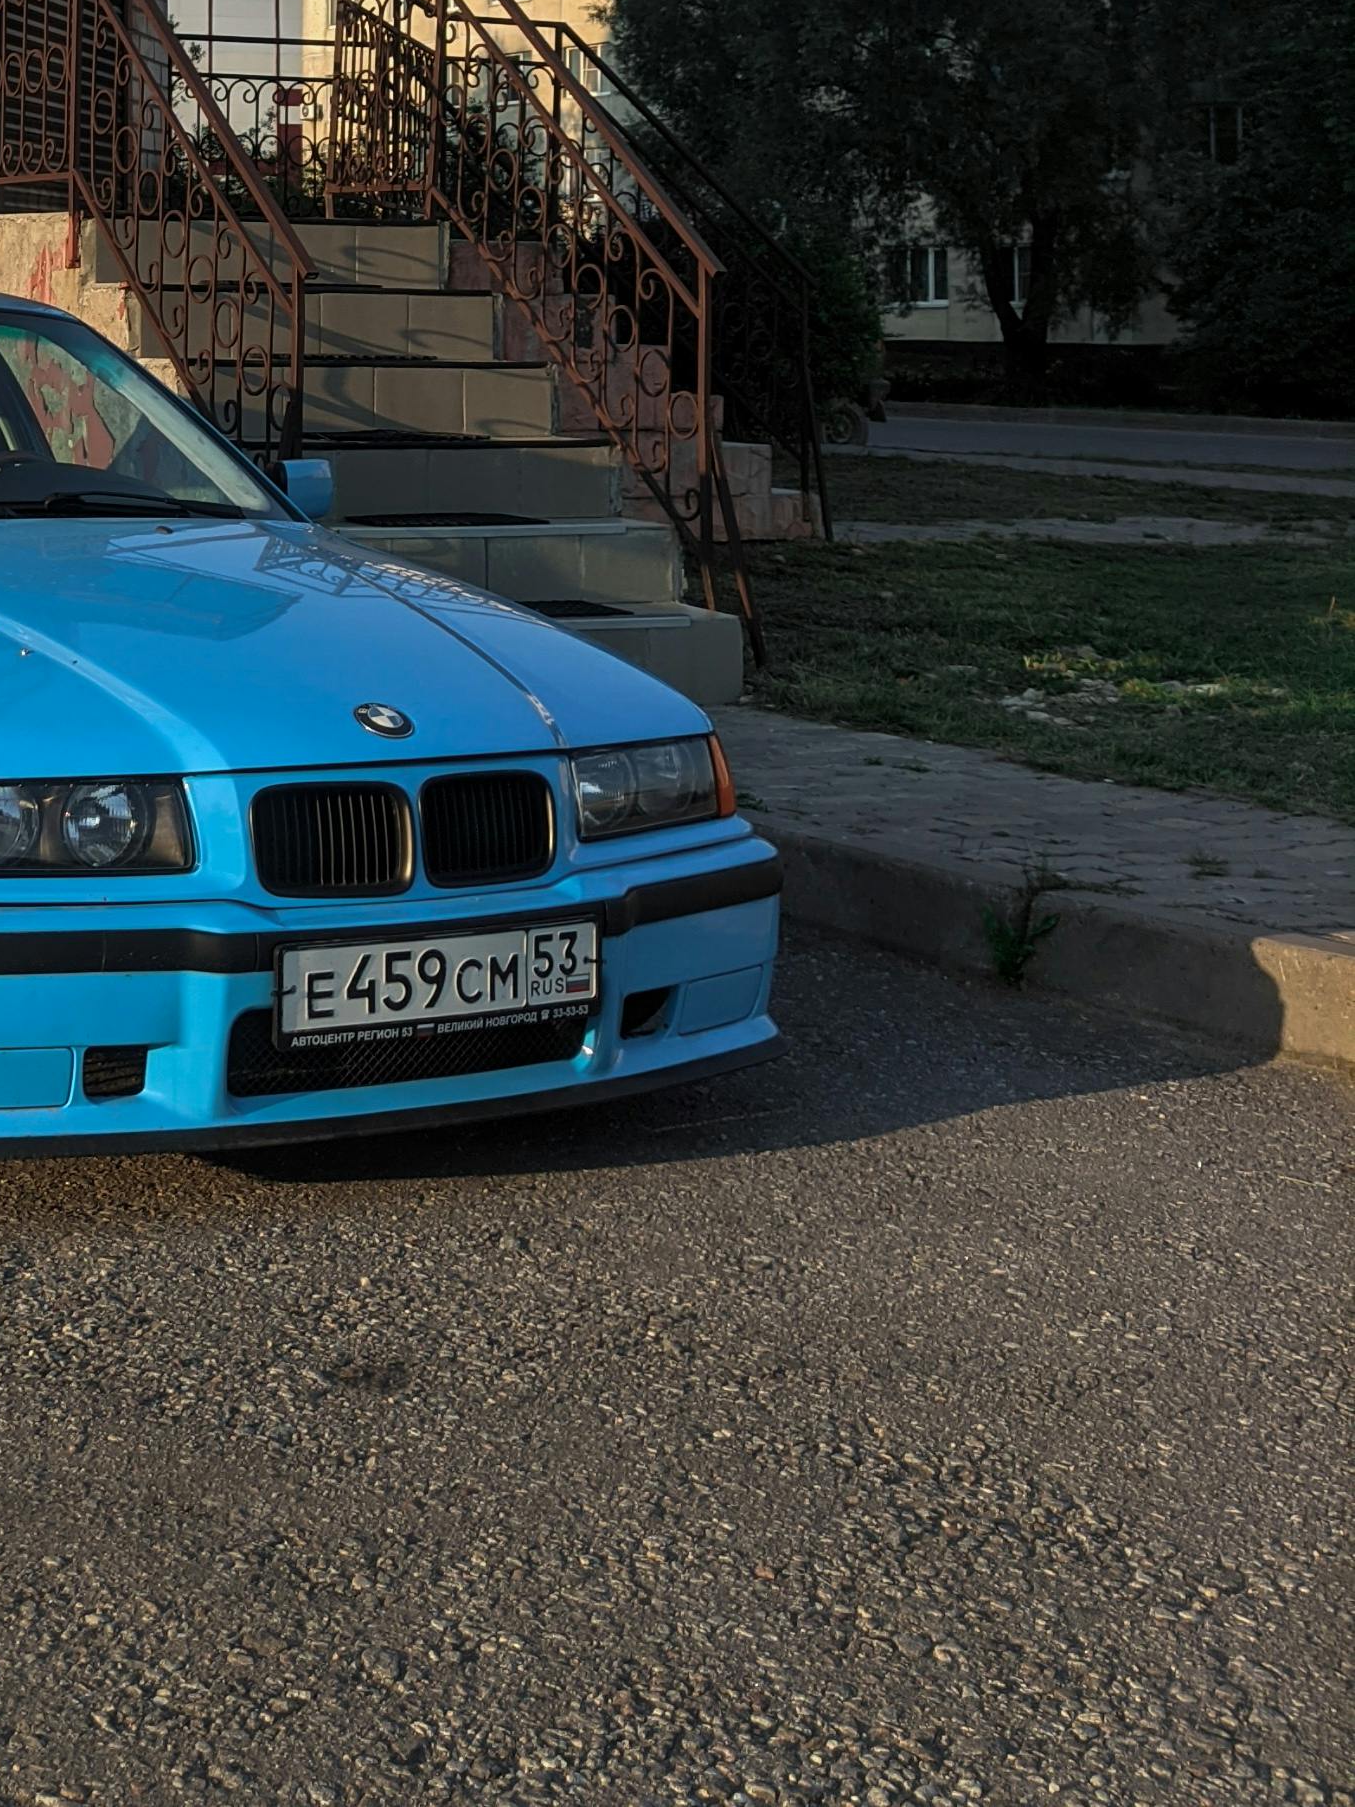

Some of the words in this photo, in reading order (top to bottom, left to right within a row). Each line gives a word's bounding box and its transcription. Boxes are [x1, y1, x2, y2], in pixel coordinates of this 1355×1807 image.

[532, 930, 578, 979] 53
[530, 977, 565, 998] RUS
[290, 1032, 355, 1048] АВТОЦЕНТР
[357, 1027, 400, 1042] РЕГИОН
[401, 1025, 414, 1038] 53
[437, 1016, 484, 1034] ВЕЛИКИЙ
[485, 1012, 538, 1029] НОВГОРОД
[552, 1004, 589, 1019] 33-53-53
